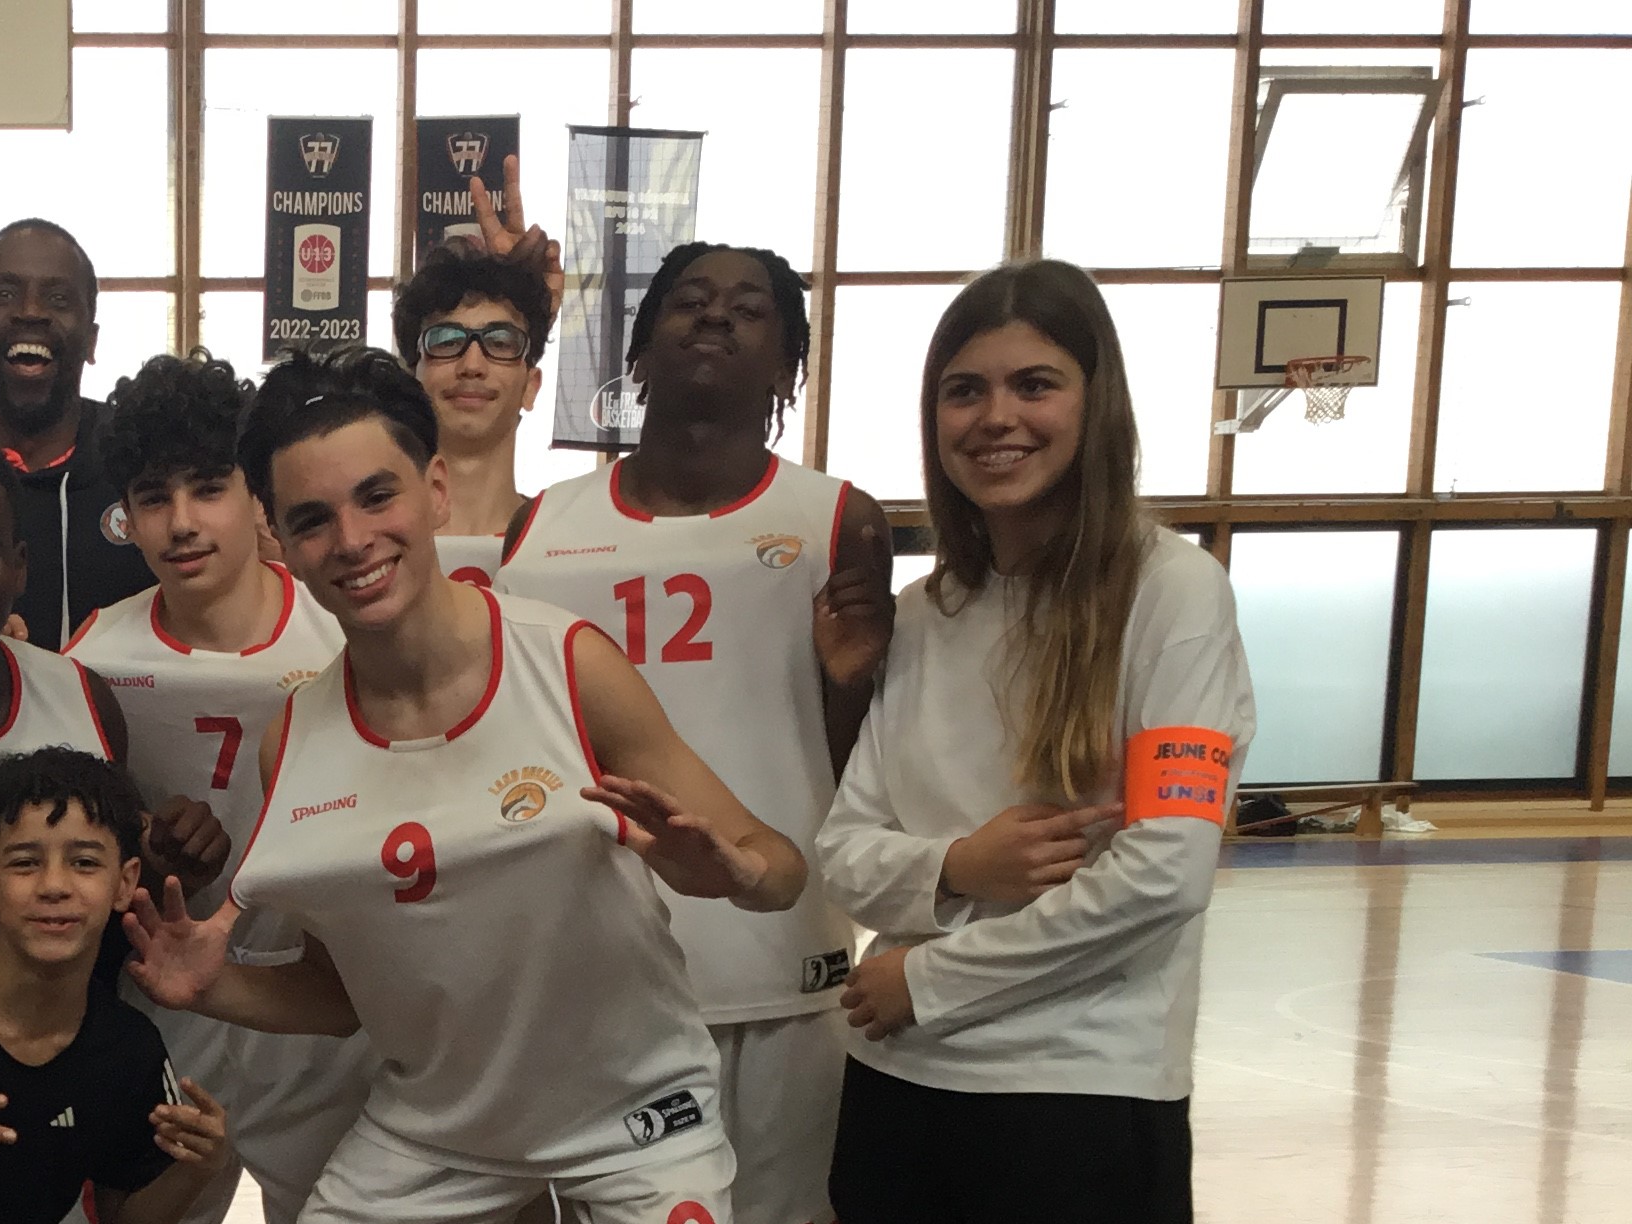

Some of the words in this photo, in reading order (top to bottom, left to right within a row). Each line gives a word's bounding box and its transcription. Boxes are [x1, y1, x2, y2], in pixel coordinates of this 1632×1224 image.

[273, 191, 363, 216] CHAMPIONS
[422, 190, 506, 215] CHAMN
[301, 247, 332, 262] U13
[270, 319, 360, 339] 2022-2023
[602, 409, 647, 428] BASKETBA
[613, 573, 713, 665] 12
[103, 675, 154, 688] ALDING
[194, 717, 243, 789] 7
[1153, 743, 1206, 760] JEUNE
[290, 794, 357, 823] SPALDING
[381, 822, 437, 903] 9
